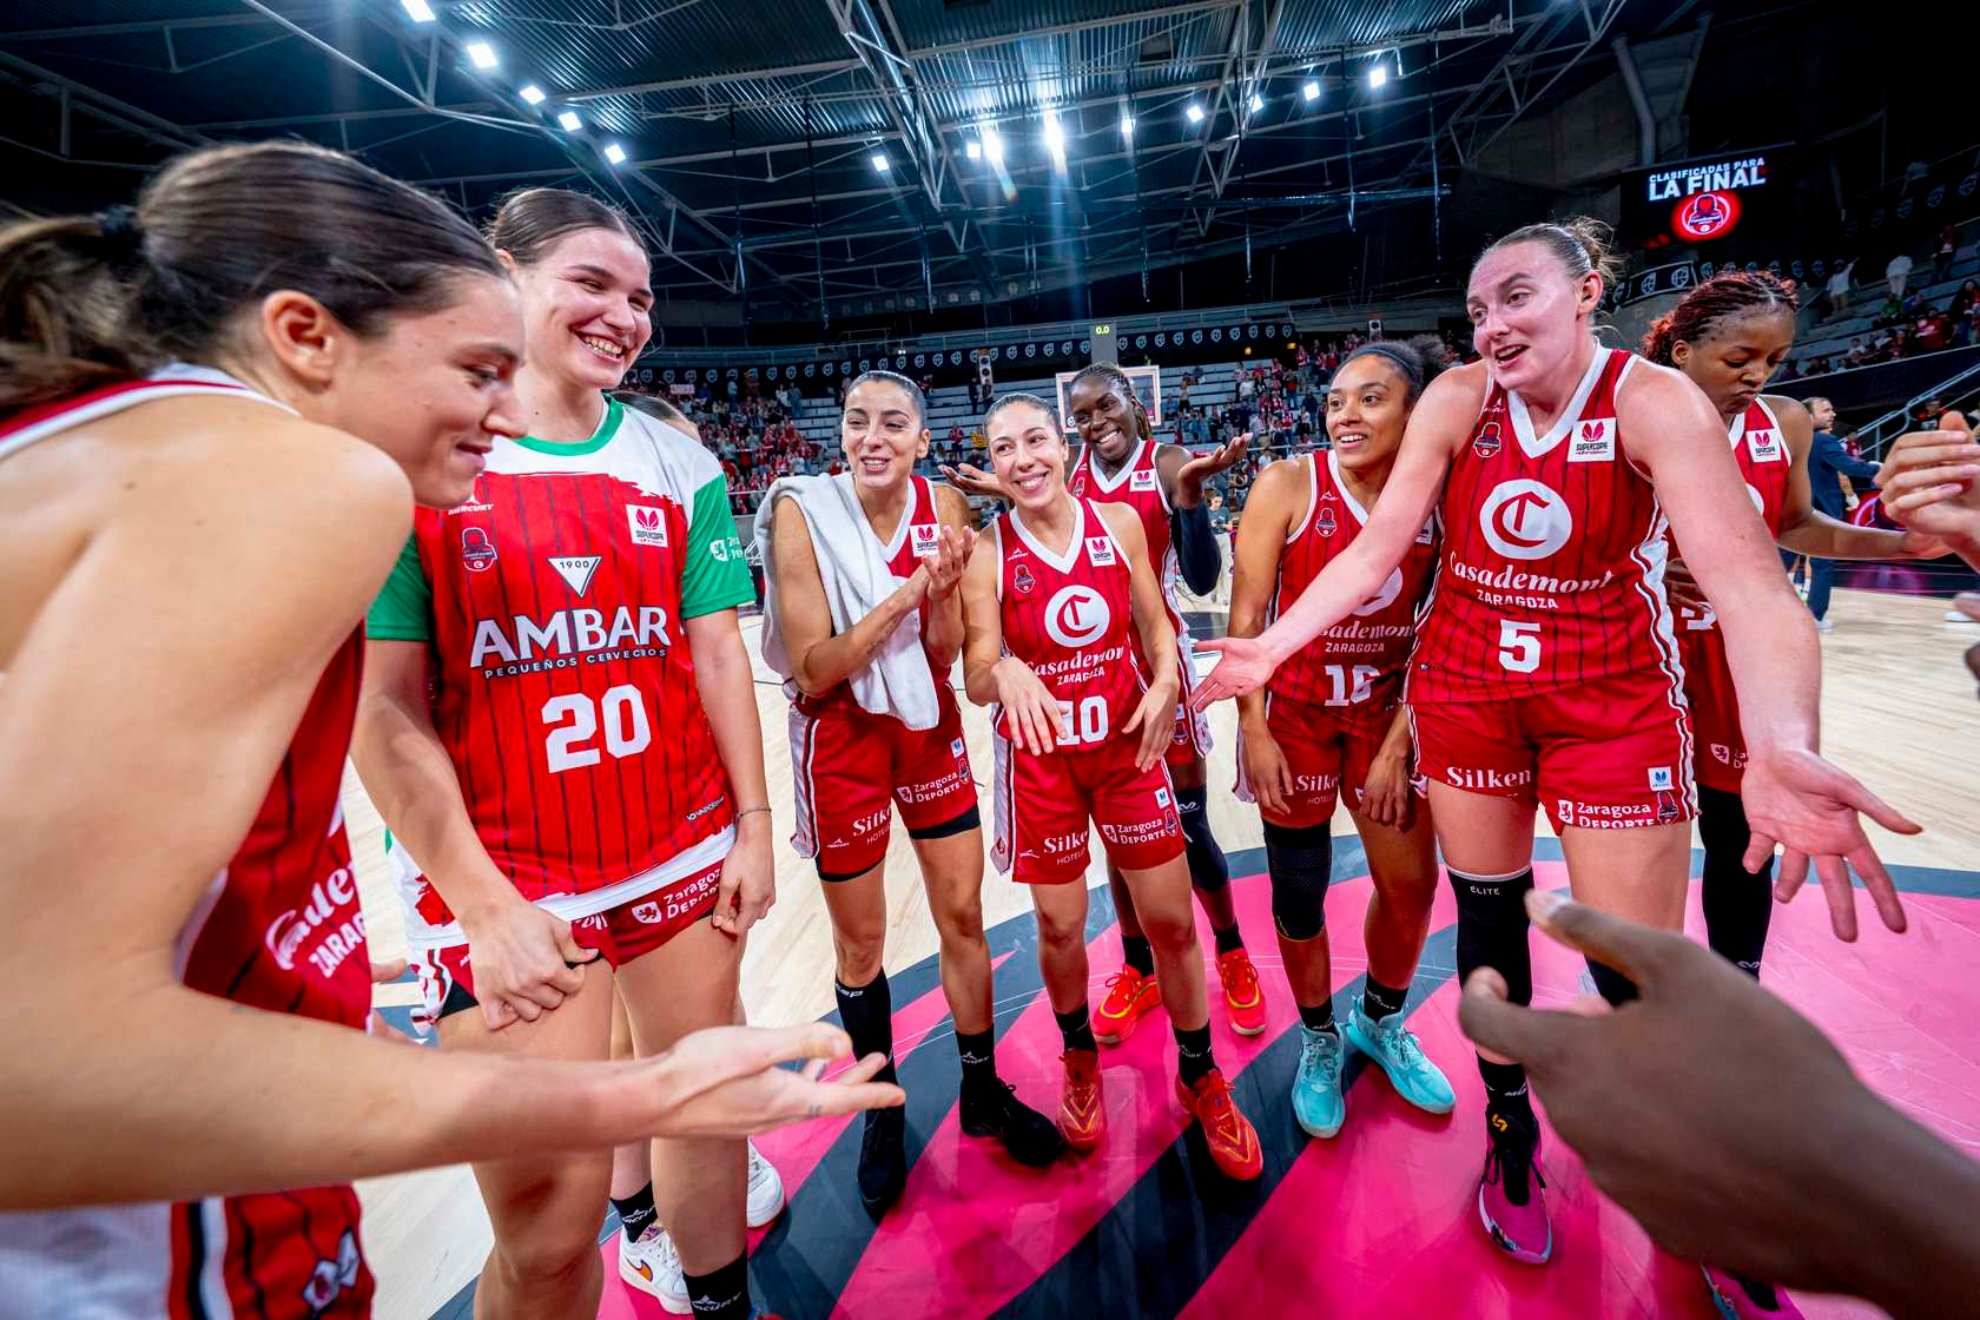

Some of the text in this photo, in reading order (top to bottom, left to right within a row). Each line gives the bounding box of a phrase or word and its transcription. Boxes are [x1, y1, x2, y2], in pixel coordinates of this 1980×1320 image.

[1649, 157, 1765, 183] CLASIFICADAS PARA
[1649, 166, 1766, 201] LA FINAL
[1096, 325, 1110, 334] 0.0
[559, 560, 590, 570] 1900
[1476, 589, 1559, 609] ZARAGOZA
[470, 606, 671, 668] AMBAR
[1325, 642, 1385, 653] ZARAGOZA
[1499, 619, 1541, 673] 5
[485, 657, 578, 679] PEQUEÑOS
[542, 683, 651, 773] 20
[1056, 695, 1109, 746] 10
[914, 771, 958, 793] Zaragoza
[1296, 774, 1338, 792] Silke
[1447, 766, 1532, 789] Silken
[916, 781, 960, 802] DEPORTE
[1577, 802, 1652, 819] Zaragoza
[1117, 818, 1163, 834] Zaragoza
[1044, 830, 1088, 854] Silke
[1120, 829, 1167, 845] DEPORTE
[1470, 886, 1500, 895] ELITE
